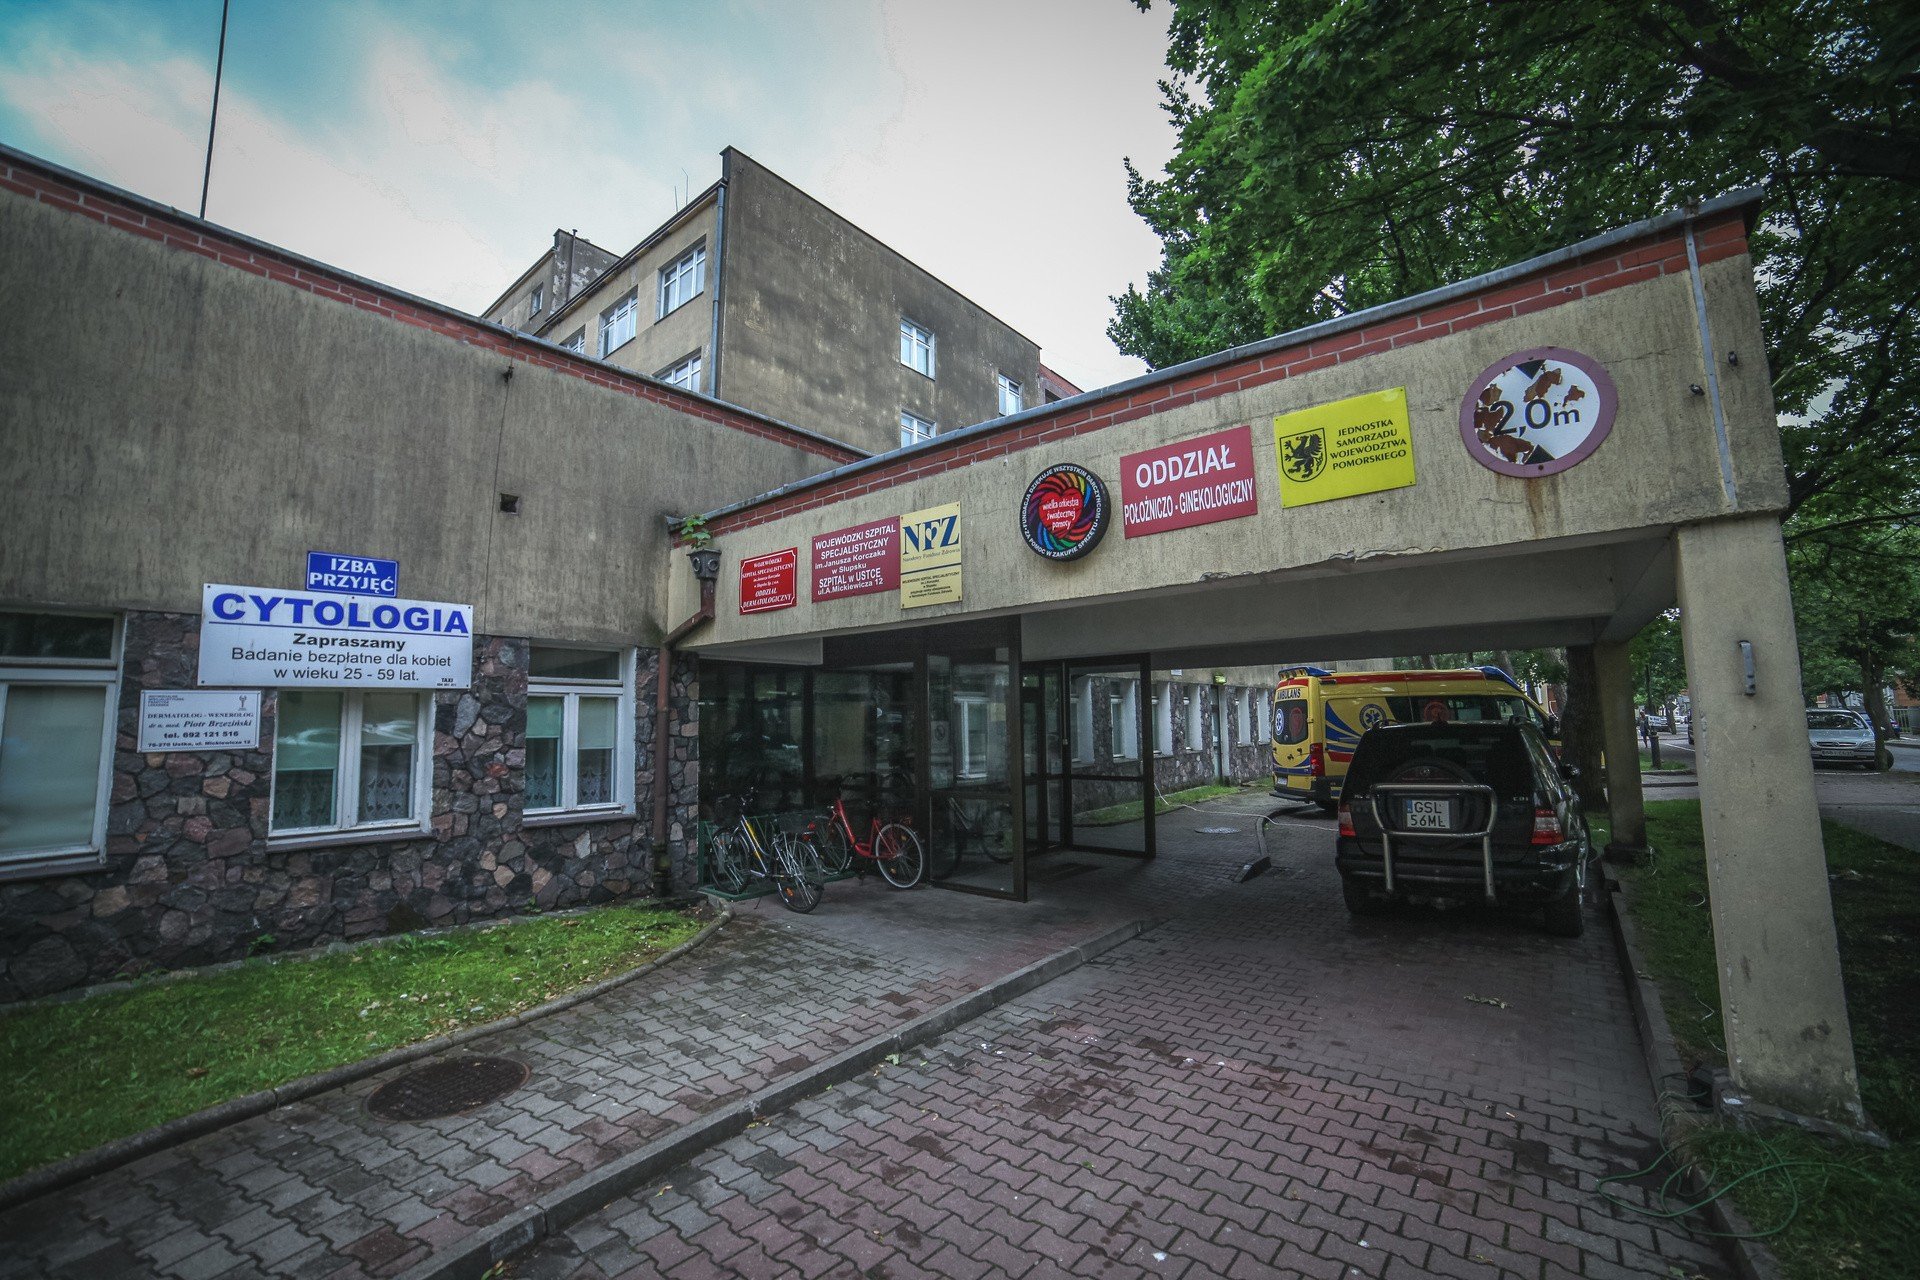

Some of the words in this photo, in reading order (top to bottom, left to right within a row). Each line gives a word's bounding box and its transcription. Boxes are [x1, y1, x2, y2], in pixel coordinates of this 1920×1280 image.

[1338, 419, 1394, 437] JEDNOSTKA
[1489, 399, 1580, 437] 2,0m
[1336, 429, 1398, 448] SAMORZĄDU
[1329, 439, 1407, 459] WOJEWÓDZTWA
[1135, 444, 1236, 488] ODDZIAŁ
[1332, 449, 1407, 470] POMORSKIEGO
[1022, 493, 1031, 528] FUNDACJA
[1053, 465, 1087, 477] WSZYSTKIM
[1179, 478, 1253, 514] GINEKOLOGICZNY
[902, 515, 960, 555] NFZ
[1052, 520, 1071, 531] pomocy
[815, 531, 864, 550] WOJEWÓDZKI
[864, 524, 896, 539] SZPITAL
[1024, 529, 1031, 540] ZA
[1028, 538, 1046, 554] POMOC
[1052, 547, 1078, 557] ZAKUPIE
[821, 537, 889, 560] SPECJALISTYCZNY
[852, 549, 886, 561] Korczaka
[331, 558, 377, 575] IZBA
[309, 572, 394, 594] PRZYJĘĆ
[819, 574, 847, 588] SZPITAL
[855, 567, 881, 581] USTCE
[743, 594, 792, 608] DERMATOLOGICZNY
[212, 593, 469, 634] CYTOLOGIA
[293, 633, 406, 652] Zapraszamy
[231, 647, 302, 662] Badanie
[308, 650, 382, 666] bezpłatne
[386, 654, 407, 665] dla
[412, 655, 451, 667] kobiet
[274, 669, 288, 678] w
[292, 667, 338, 679] wieku
[343, 668, 362, 680] 25
[377, 668, 395, 681] 59
[399, 670, 419, 681] lat.
[1277, 688, 1301, 700] AMBULANS
[1414, 801, 1442, 814] GSL
